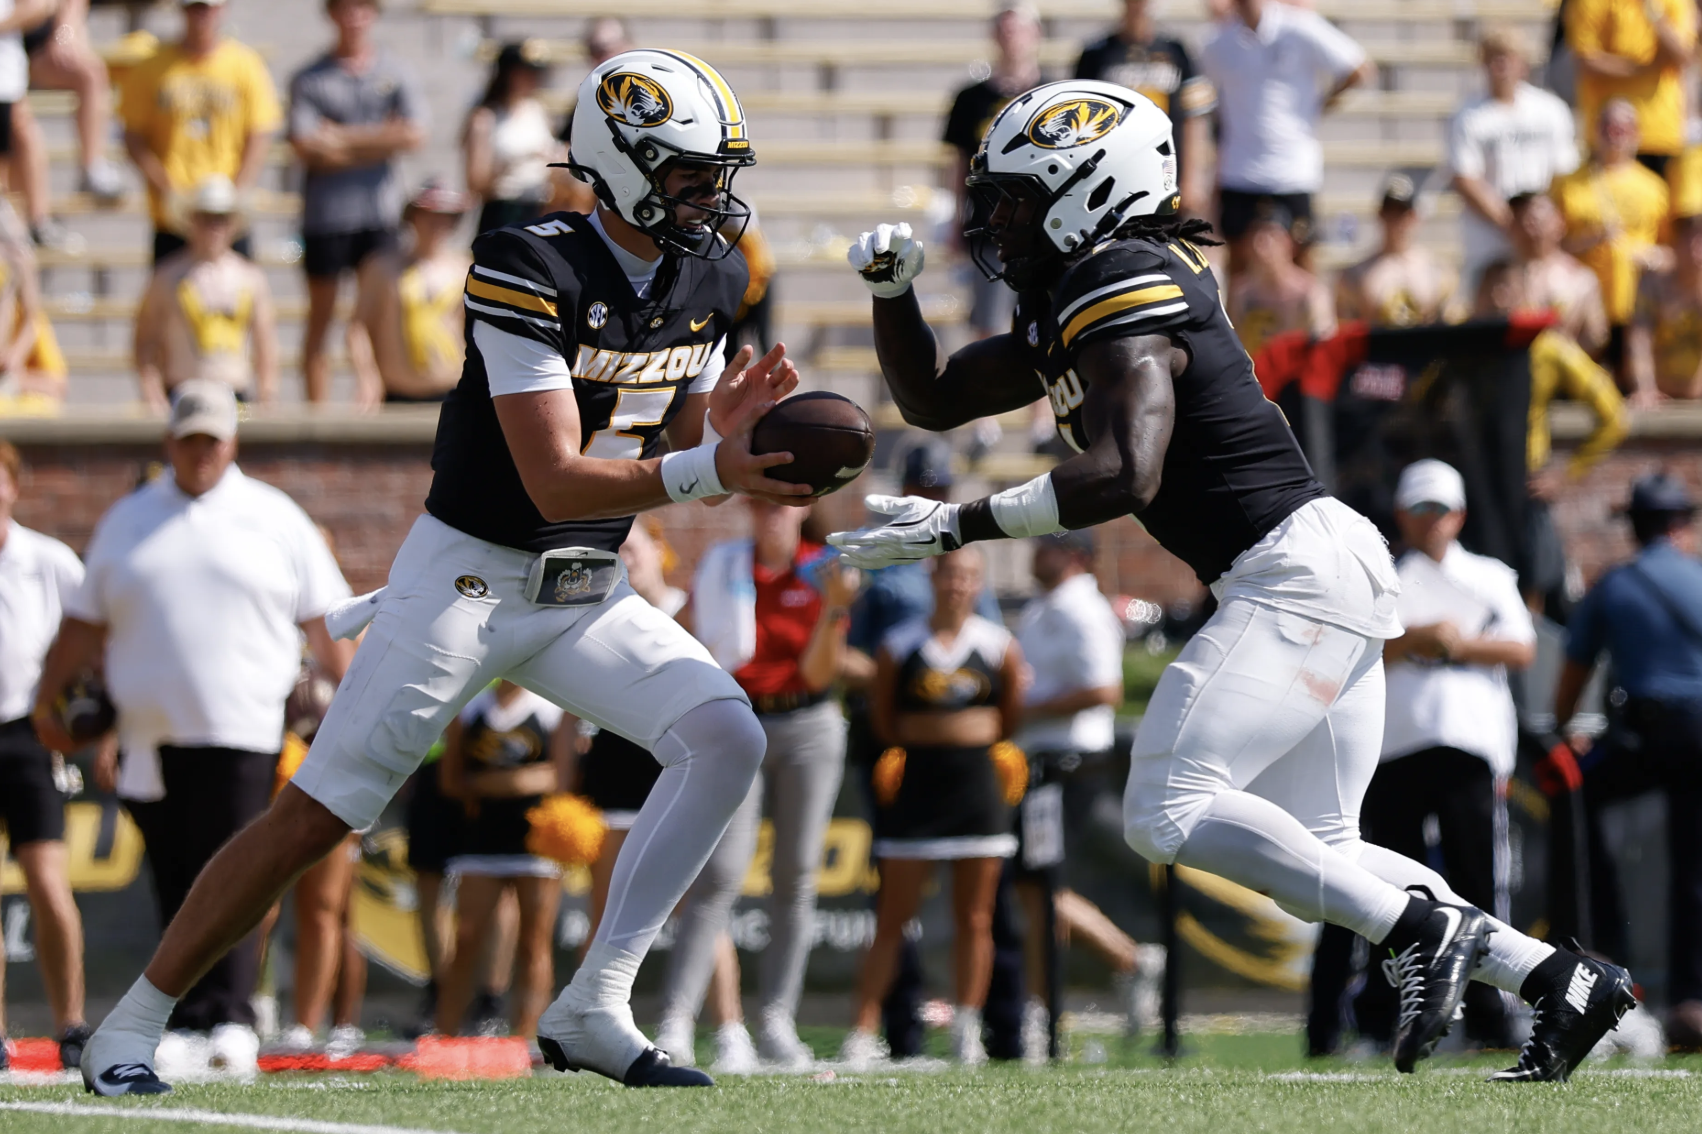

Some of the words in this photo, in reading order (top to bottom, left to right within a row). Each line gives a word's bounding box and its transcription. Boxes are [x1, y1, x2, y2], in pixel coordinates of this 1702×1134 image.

[523, 218, 576, 237] 5
[589, 303, 606, 328] SEC
[571, 341, 713, 384] MIZZOU
[581, 386, 677, 461] 5
[1564, 961, 1599, 1016] NIKE
